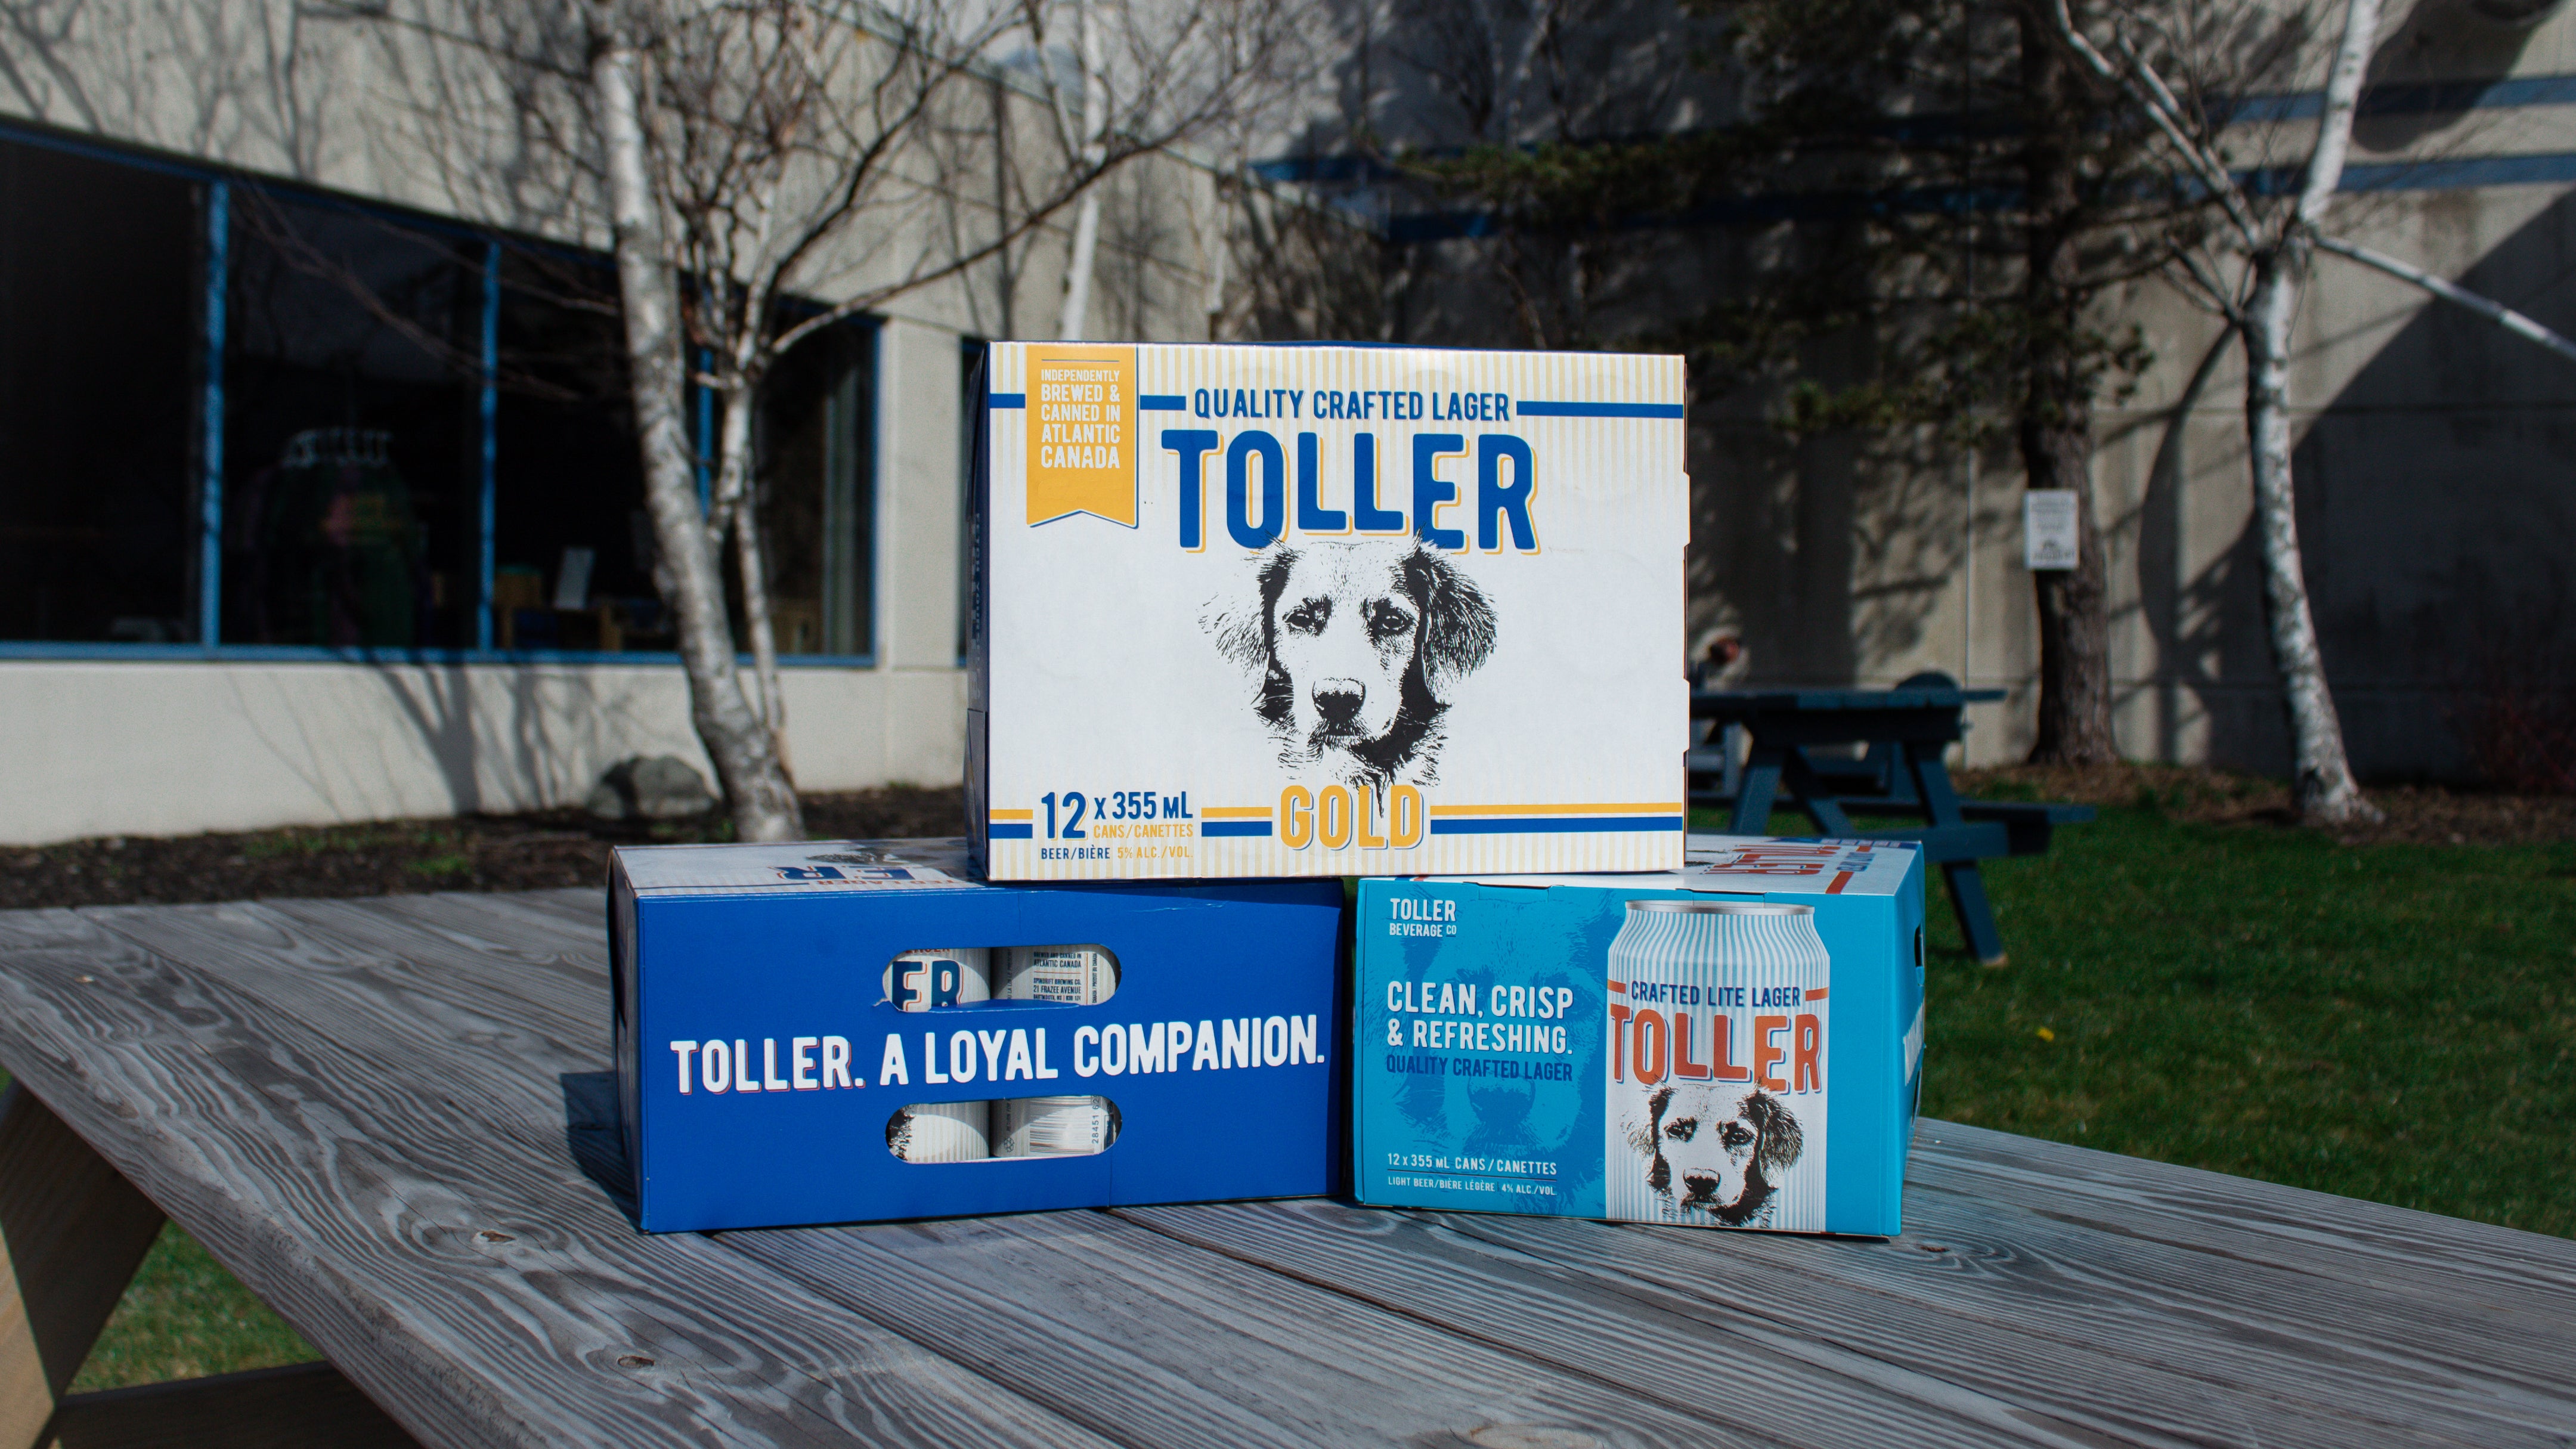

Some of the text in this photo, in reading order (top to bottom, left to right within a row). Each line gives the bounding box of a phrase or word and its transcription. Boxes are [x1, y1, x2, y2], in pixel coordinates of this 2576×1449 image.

[1041, 369, 1120, 382] INDEPENDENTLY
[1041, 383, 1120, 402] BREWED &
[1041, 404, 1120, 422] CANNED IN
[1195, 388, 1510, 422] QUALITY CRAFTED LAGER
[1042, 424, 1120, 444] ATLANTIC
[1041, 445, 1120, 469] CANADA
[1161, 430, 1539, 556] TOLLER
[1041, 792, 1089, 841] 12
[1112, 791, 1156, 819] 355
[1281, 785, 1424, 851] GOLD
[1094, 824, 1193, 838] CANS/CANETTES
[1041, 844, 1111, 860] BEER/BIÈRE
[1117, 847, 1132, 859] 5%
[1390, 898, 1457, 921] TOLLER
[1389, 923, 1457, 937] BEVERAGE CO
[1034, 959, 1058, 967] ATLANTIC
[1061, 986, 1081, 994] AVENUE
[1388, 981, 1573, 1019] CLEAN, CRISP
[1631, 980, 1800, 1007] CRAFTED LITE LAGER
[1387, 1018, 1572, 1055] & REFRESHING.
[670, 1014, 1325, 1095] TOLLER. A LOYAL COMPANION.
[1610, 1003, 1822, 1094] TOLLER
[1386, 1054, 1572, 1081] QUALITY CRAFTED LAGER
[1388, 1153, 1400, 1166] 12
[1411, 1154, 1432, 1168] 355
[1388, 1176, 1411, 1186] LIGHT
[1414, 1177, 1462, 1190] BEER/BIÈRE
[1465, 1179, 1495, 1192] LÉGÈRE
[1502, 1183, 1513, 1193] 4%
